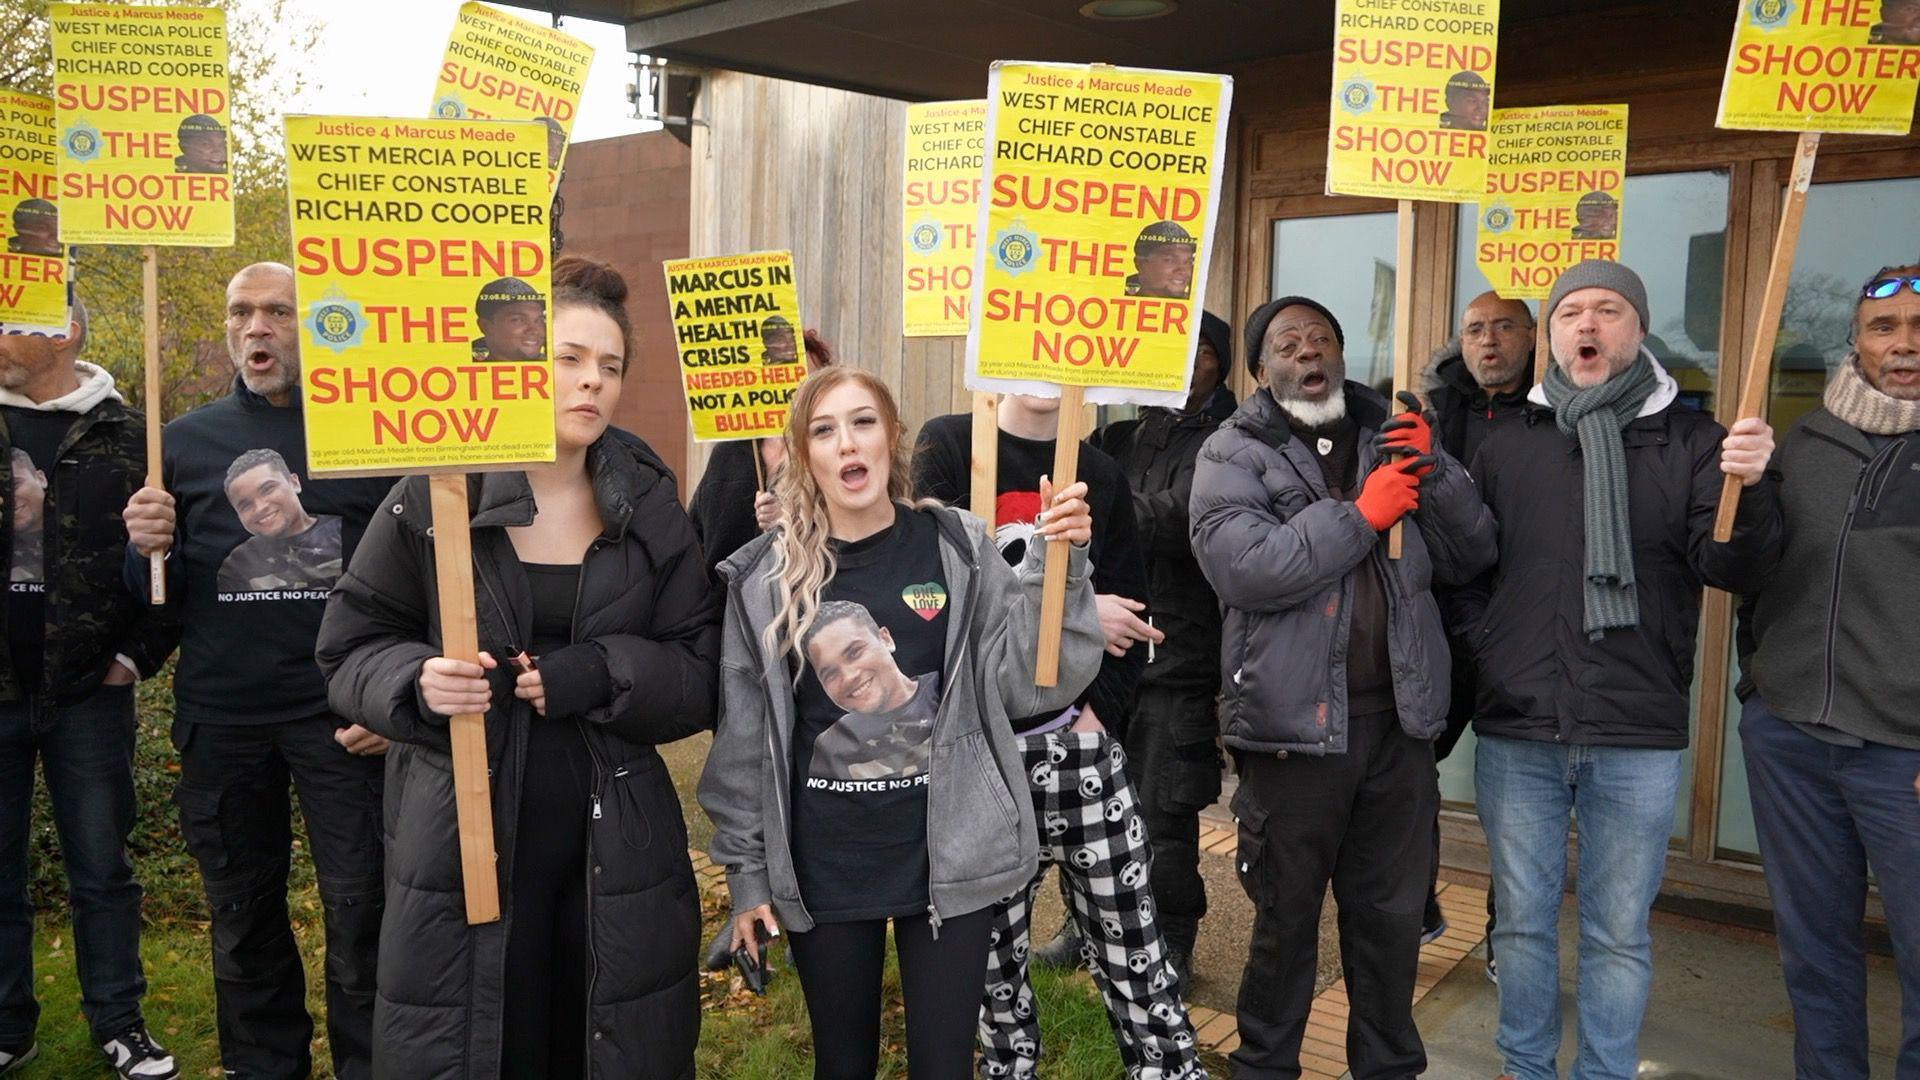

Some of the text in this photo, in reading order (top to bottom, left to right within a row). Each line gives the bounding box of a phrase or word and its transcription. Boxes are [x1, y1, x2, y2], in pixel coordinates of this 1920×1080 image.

[70, 7, 204, 20] Justice 4 Marcus Meade
[475, 6, 506, 22] Justice
[1356, 0, 1485, 16] CHIEF CONSTABLE
[55, 21, 221, 38] WEST MERCIA POLICE
[1341, 14, 1494, 36] RICHARD COOPER
[71, 41, 212, 57] CHIEF CONSTABLE
[460, 13, 589, 66] WEST MERCIA POLICE
[466, 31, 576, 77] CHIEF CONSTABLE
[1338, 39, 1492, 71] SUSPEND
[1735, 44, 1920, 79] SHOOTER
[57, 60, 224, 77] RICHARD COOPER
[449, 41, 580, 95] RICHARD COOPER
[440, 62, 573, 122] SUSPEND
[1024, 73, 1192, 97] Justice 4 Marcus Meade
[58, 84, 225, 114] SUSPEND
[1002, 91, 1212, 123] WEST MERCIA POLICE
[1376, 85, 1440, 114] THE
[1777, 82, 1877, 114] NOW
[11, 111, 56, 129] POLIC
[1500, 112, 1531, 120] Justice
[1525, 121, 1573, 133] MERCIA
[1577, 120, 1623, 130] POLICE
[315, 122, 516, 142] Justice 4 Marcus Meade
[910, 121, 985, 135] WEST MER
[1019, 118, 1196, 147] CHIEF CONSTABLE
[103, 131, 173, 159] THE
[922, 140, 962, 152] CHIEF
[1335, 126, 1487, 159] SHOOTER
[1497, 135, 1614, 149] CHIEF CONSTABLE
[0, 145, 57, 165] OOPE
[292, 144, 542, 168] WEST MERCIA POLICE
[909, 155, 984, 171] RICHARD
[997, 140, 1103, 167] RICHARD
[1109, 150, 1207, 175] COOPER
[1557, 150, 1621, 162] COOPER
[1372, 157, 1452, 186] NOW
[1487, 170, 1619, 193] SUSPEND
[63, 173, 229, 201] SHOOTER
[317, 173, 527, 195] CHIEF CONSTABLE
[992, 174, 1201, 222] SUSPEND
[105, 204, 193, 230] NOW
[296, 199, 543, 225] RICHARD COOPER
[1514, 208, 1571, 229] THE
[297, 237, 544, 277] SUSPEND
[1042, 238, 1127, 277] THE
[1479, 242, 1616, 263] SHOOTER
[670, 265, 791, 294] MARCUS IN
[675, 293, 780, 319] A MENTAL
[985, 289, 1188, 335] SHOOTER
[365, 306, 469, 343] THE
[678, 320, 759, 343] HEALTH
[682, 346, 750, 368] CRISIS
[1033, 330, 1140, 368] NOW
[309, 366, 550, 404] SHOOTER
[686, 367, 806, 390] NEEDED HELP
[689, 394, 726, 411] NOT
[732, 393, 745, 411] A
[373, 408, 499, 445] NOW
[715, 410, 787, 432] BULLET
[235, 592, 280, 601] JUSTICE
[283, 591, 302, 599] NO
[913, 586, 937, 599] ONE
[913, 598, 940, 610] LOVE
[807, 778, 911, 792] NO JUSTICE NO
